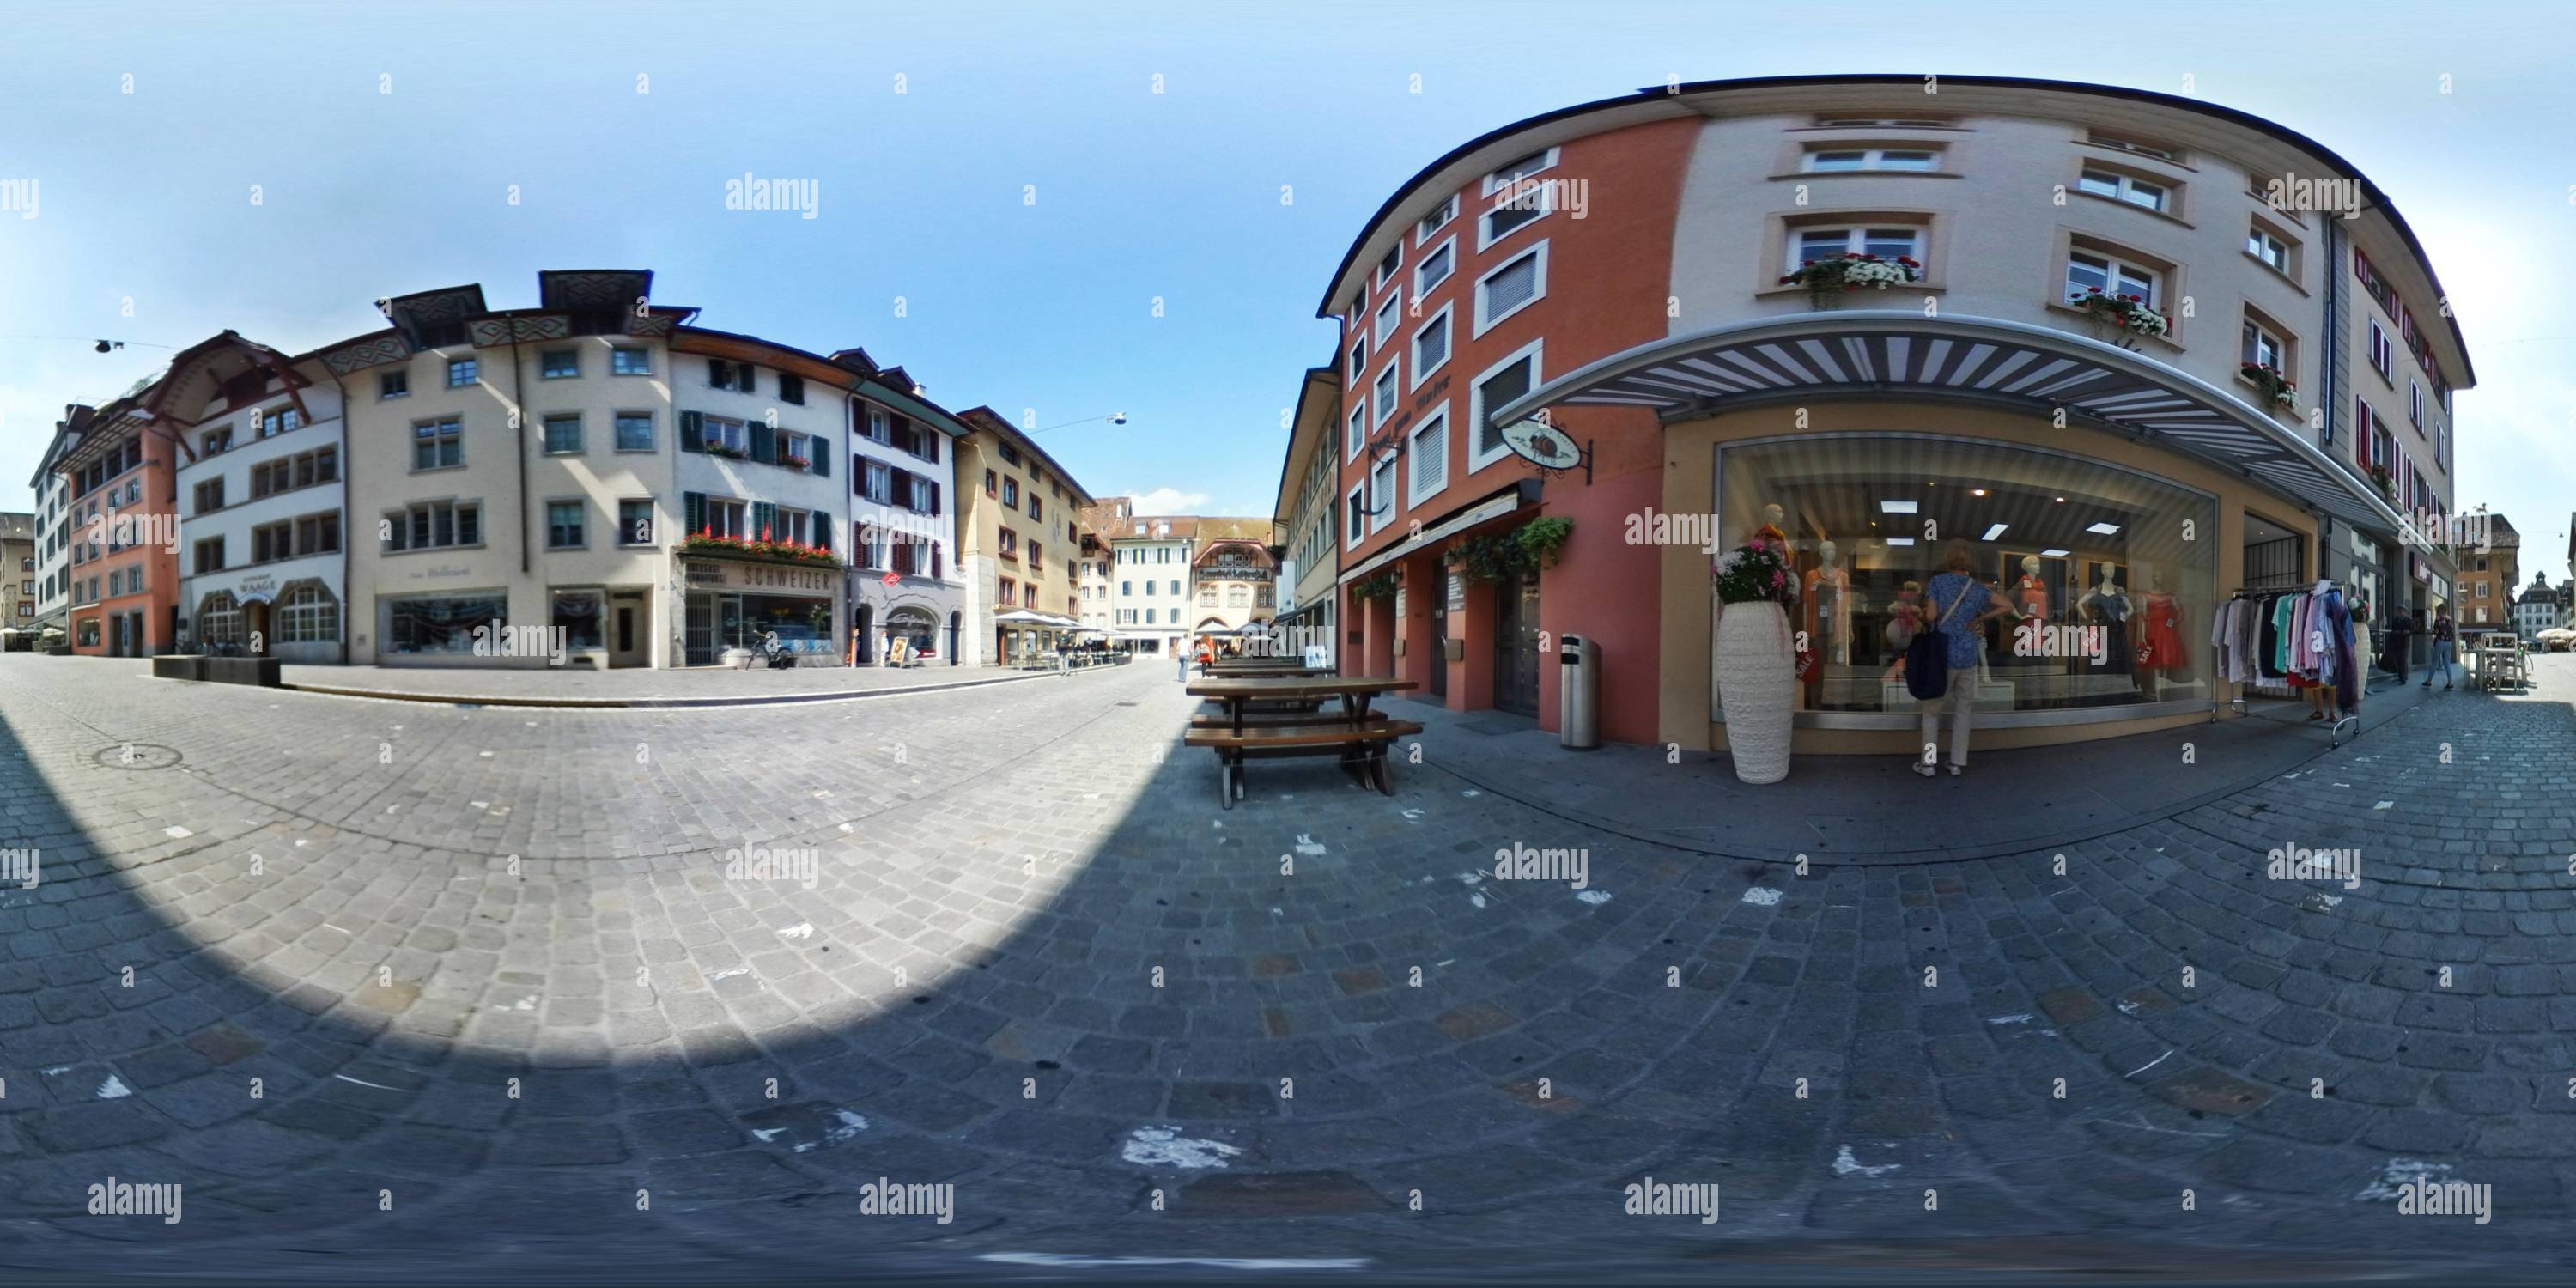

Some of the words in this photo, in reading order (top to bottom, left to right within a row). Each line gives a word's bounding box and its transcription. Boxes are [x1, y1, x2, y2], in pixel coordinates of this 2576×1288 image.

[239, 580, 276, 592] WAAGE
[744, 566, 830, 590] SCHWEIZER
[1795, 653, 1814, 677] SALE
[2139, 645, 2154, 664] SALE
